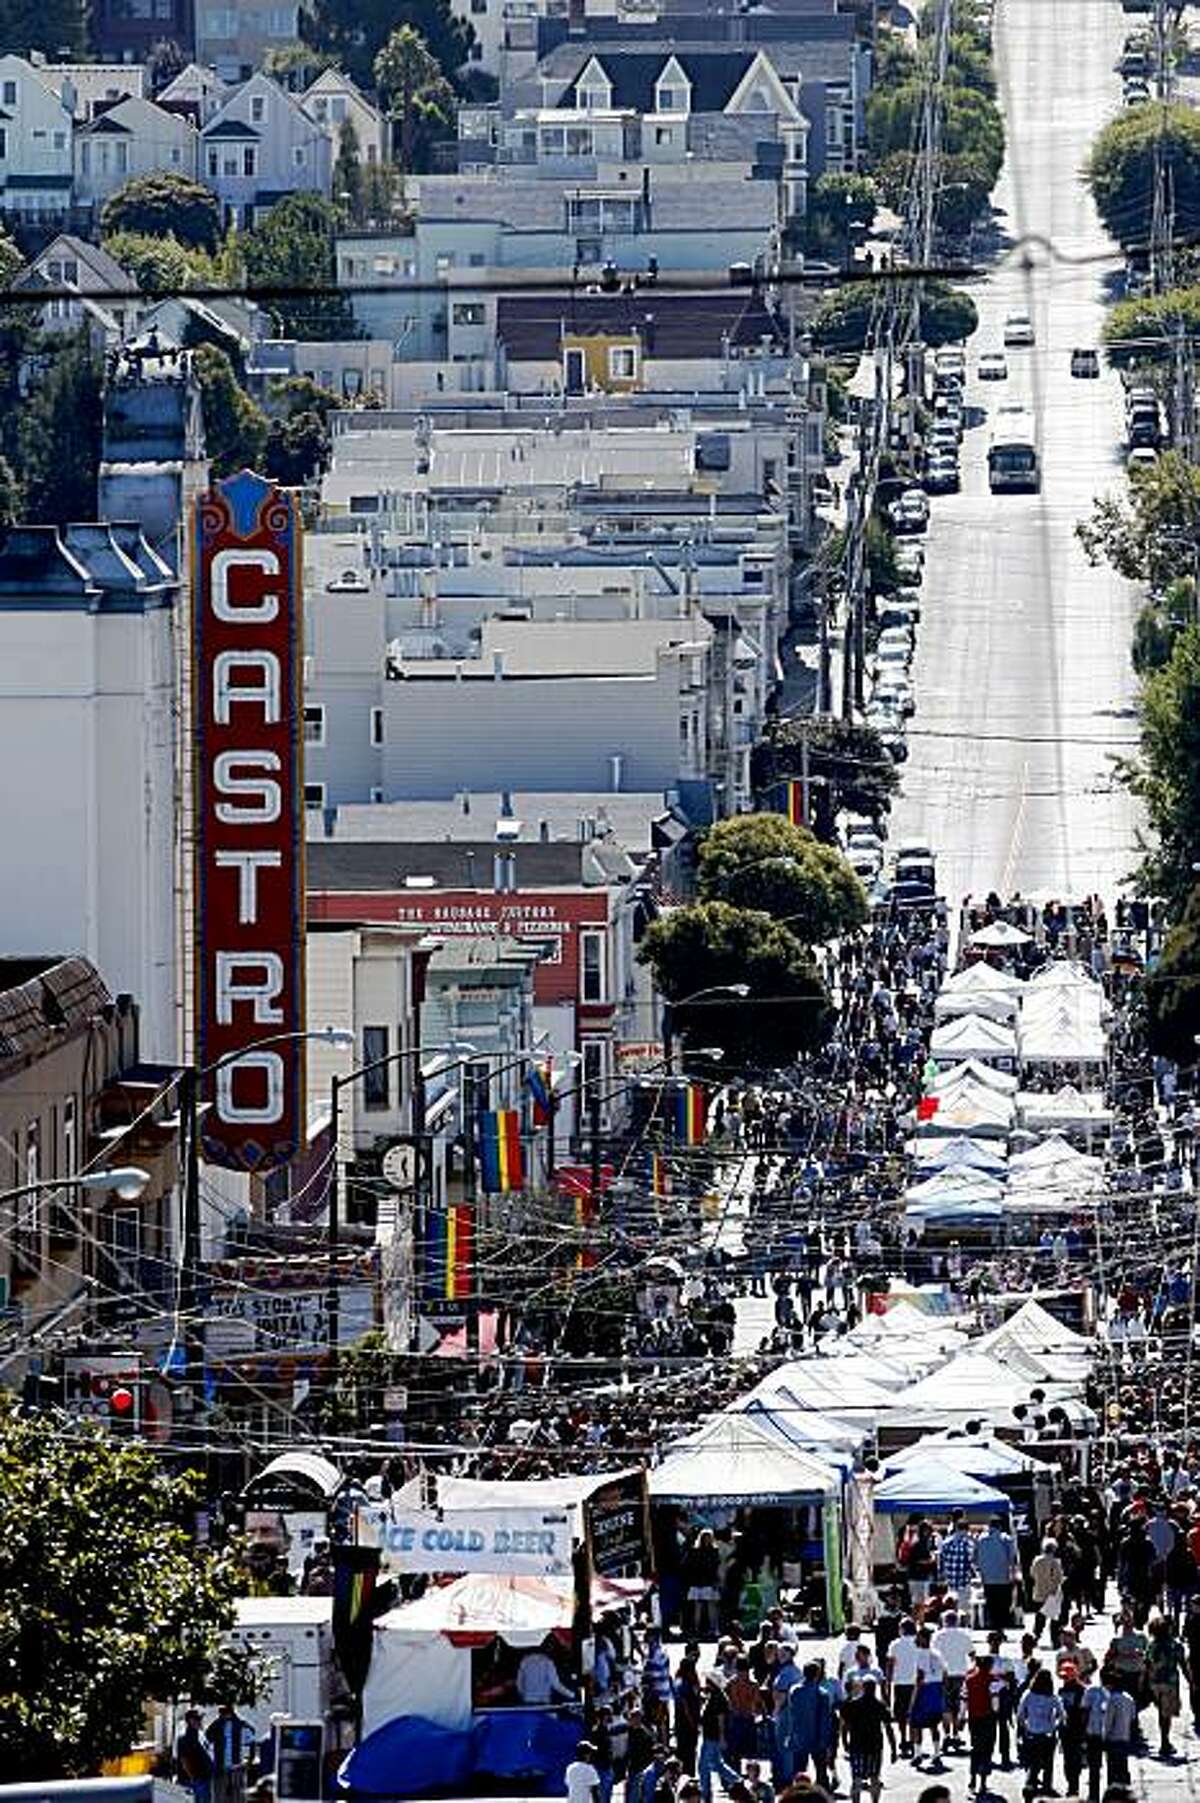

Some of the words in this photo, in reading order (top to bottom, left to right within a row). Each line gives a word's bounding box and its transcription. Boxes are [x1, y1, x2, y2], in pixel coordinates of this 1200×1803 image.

[210, 548, 284, 1124] CASTRO
[398, 907, 423, 920] THE
[251, 1296, 303, 1315] STORY
[379, 1523, 415, 1551] ICE
[422, 1527, 485, 1552] COLD
[494, 1527, 555, 1554] BEER
